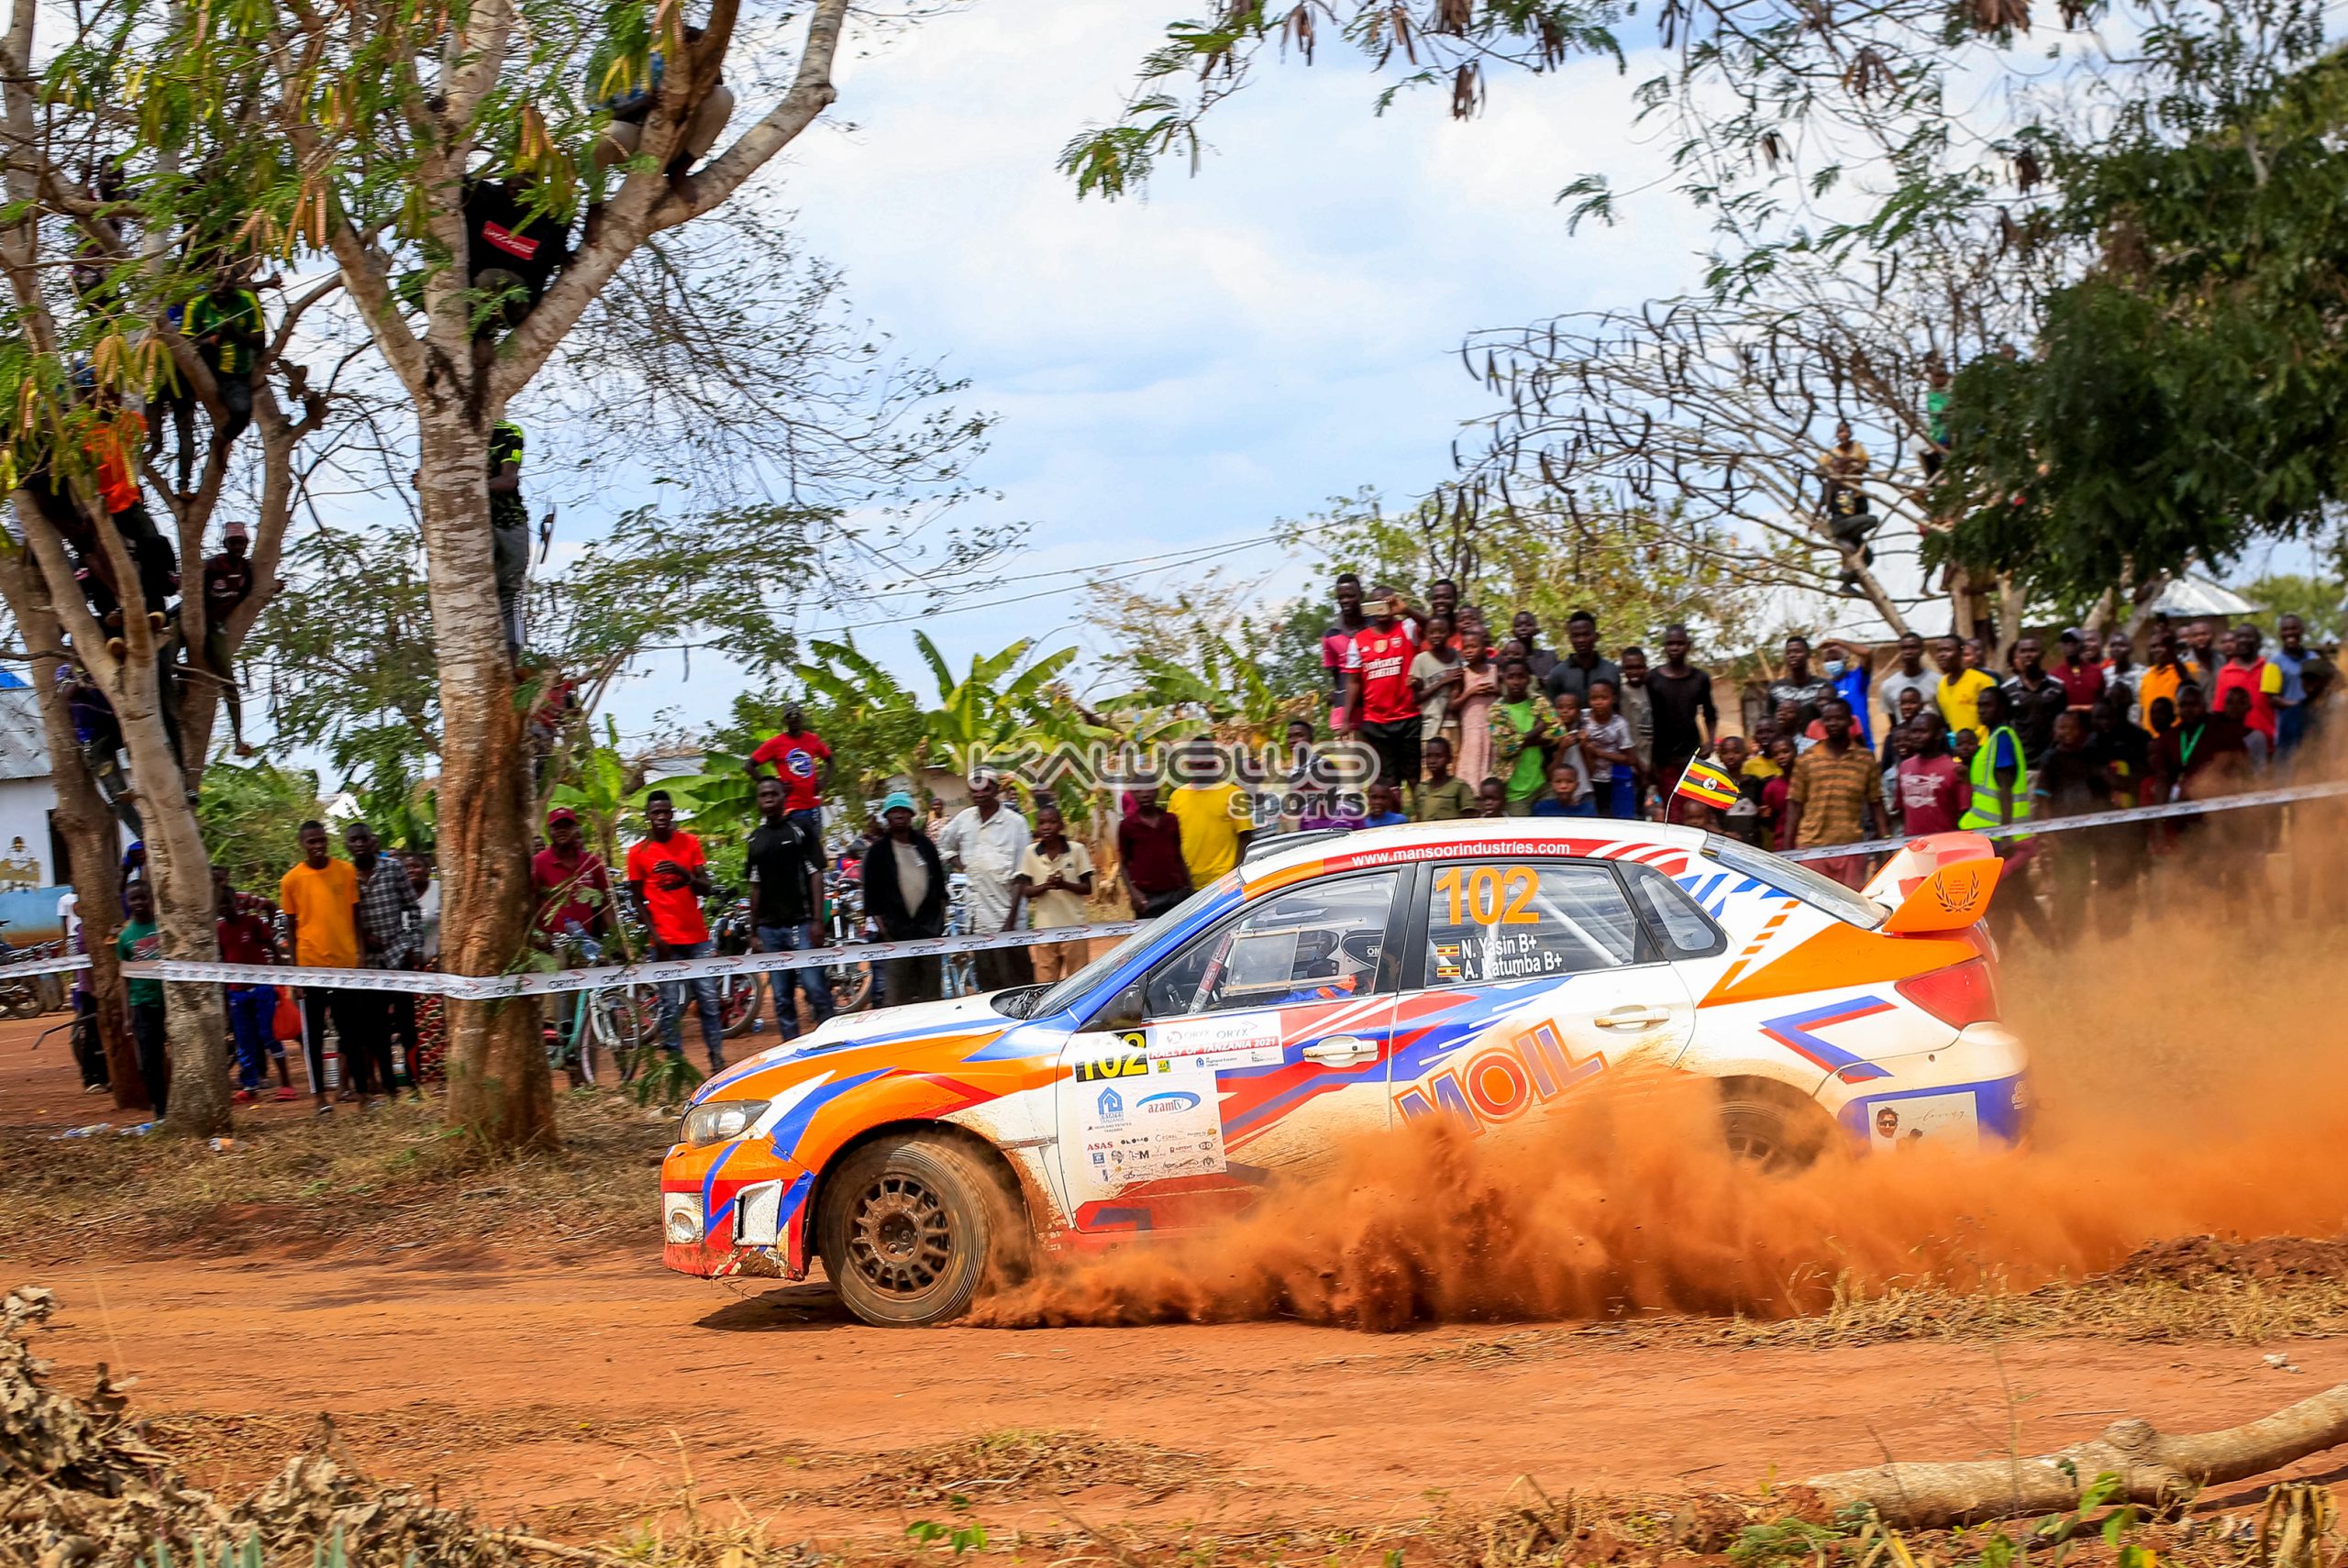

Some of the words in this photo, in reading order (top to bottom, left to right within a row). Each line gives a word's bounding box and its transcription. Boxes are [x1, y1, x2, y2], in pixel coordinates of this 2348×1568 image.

[1351, 840, 1571, 867] www.mansoorindustries.com
[1435, 865, 1541, 926] 102
[1367, 947, 1380, 955] OM
[1461, 938, 1477, 959] N.
[1479, 934, 1516, 956] Yasin
[1518, 933, 1537, 954] B+
[1464, 959, 1479, 980] A.
[1481, 954, 1542, 979] Katumba
[1543, 950, 1563, 971] B+
[1254, 1037, 1277, 1047] 2021
[1394, 1018, 1611, 1135] MOIL
[1087, 1141, 1113, 1152] ASAS
